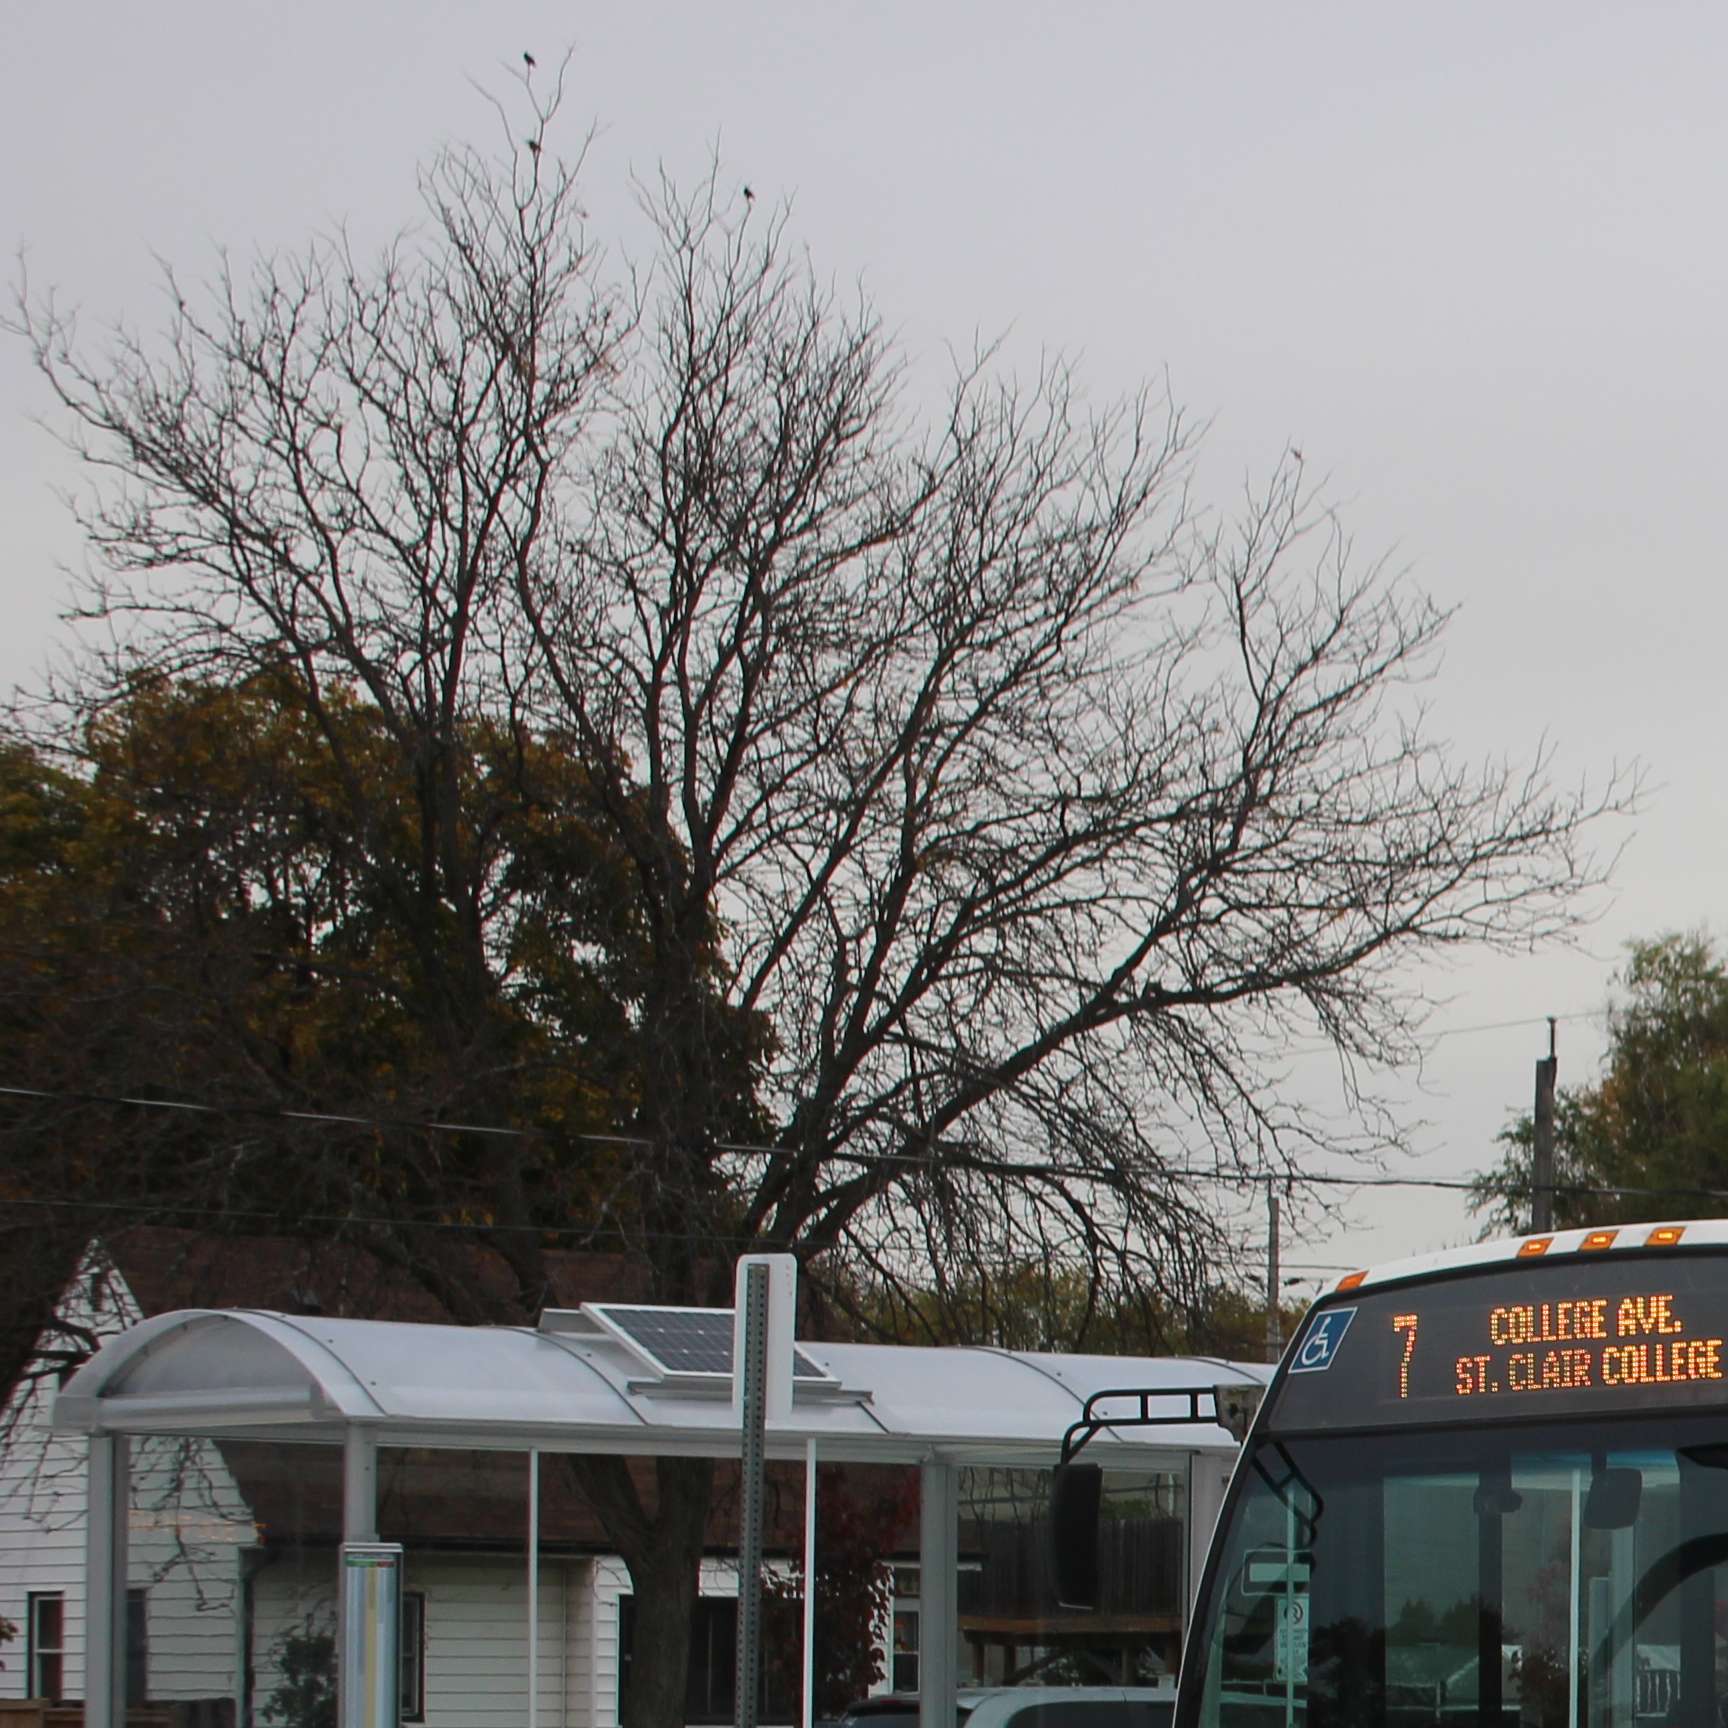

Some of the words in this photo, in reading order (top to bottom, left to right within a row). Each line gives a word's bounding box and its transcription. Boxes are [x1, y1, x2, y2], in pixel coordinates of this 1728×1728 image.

[1490, 1299, 1608, 1345] COLLEGE
[1617, 1294, 1682, 1336] AVE.
[1393, 1313, 1418, 1399] 7
[1456, 1354, 1499, 1395] ST.
[1508, 1348, 1593, 1391] CLAIR
[1601, 1338, 1723, 1385] COLLEGE
